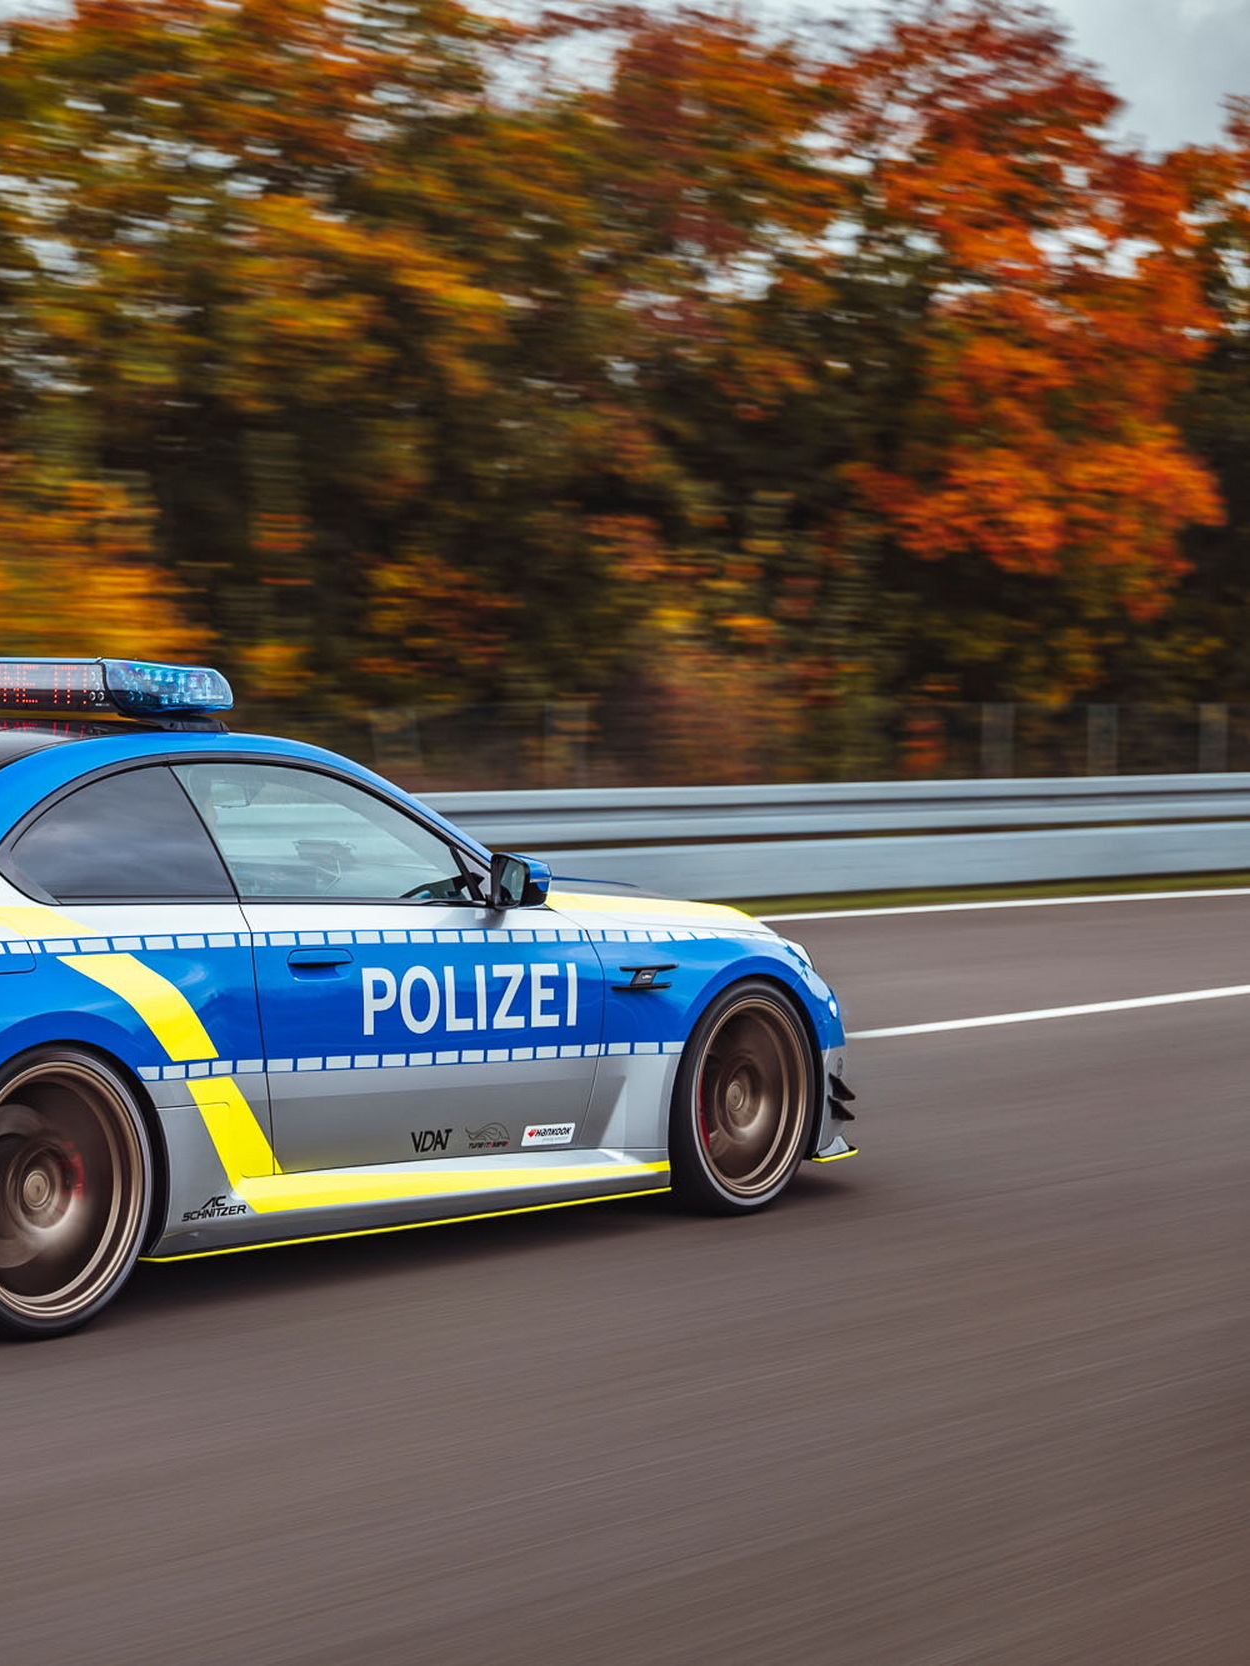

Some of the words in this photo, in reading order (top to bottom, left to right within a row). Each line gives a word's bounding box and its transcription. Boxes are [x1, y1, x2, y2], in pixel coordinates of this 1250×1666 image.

[361, 962, 578, 1036] POLIZEI
[411, 1129, 453, 1153] VDAT
[181, 1204, 247, 1222] SCHNITZER
